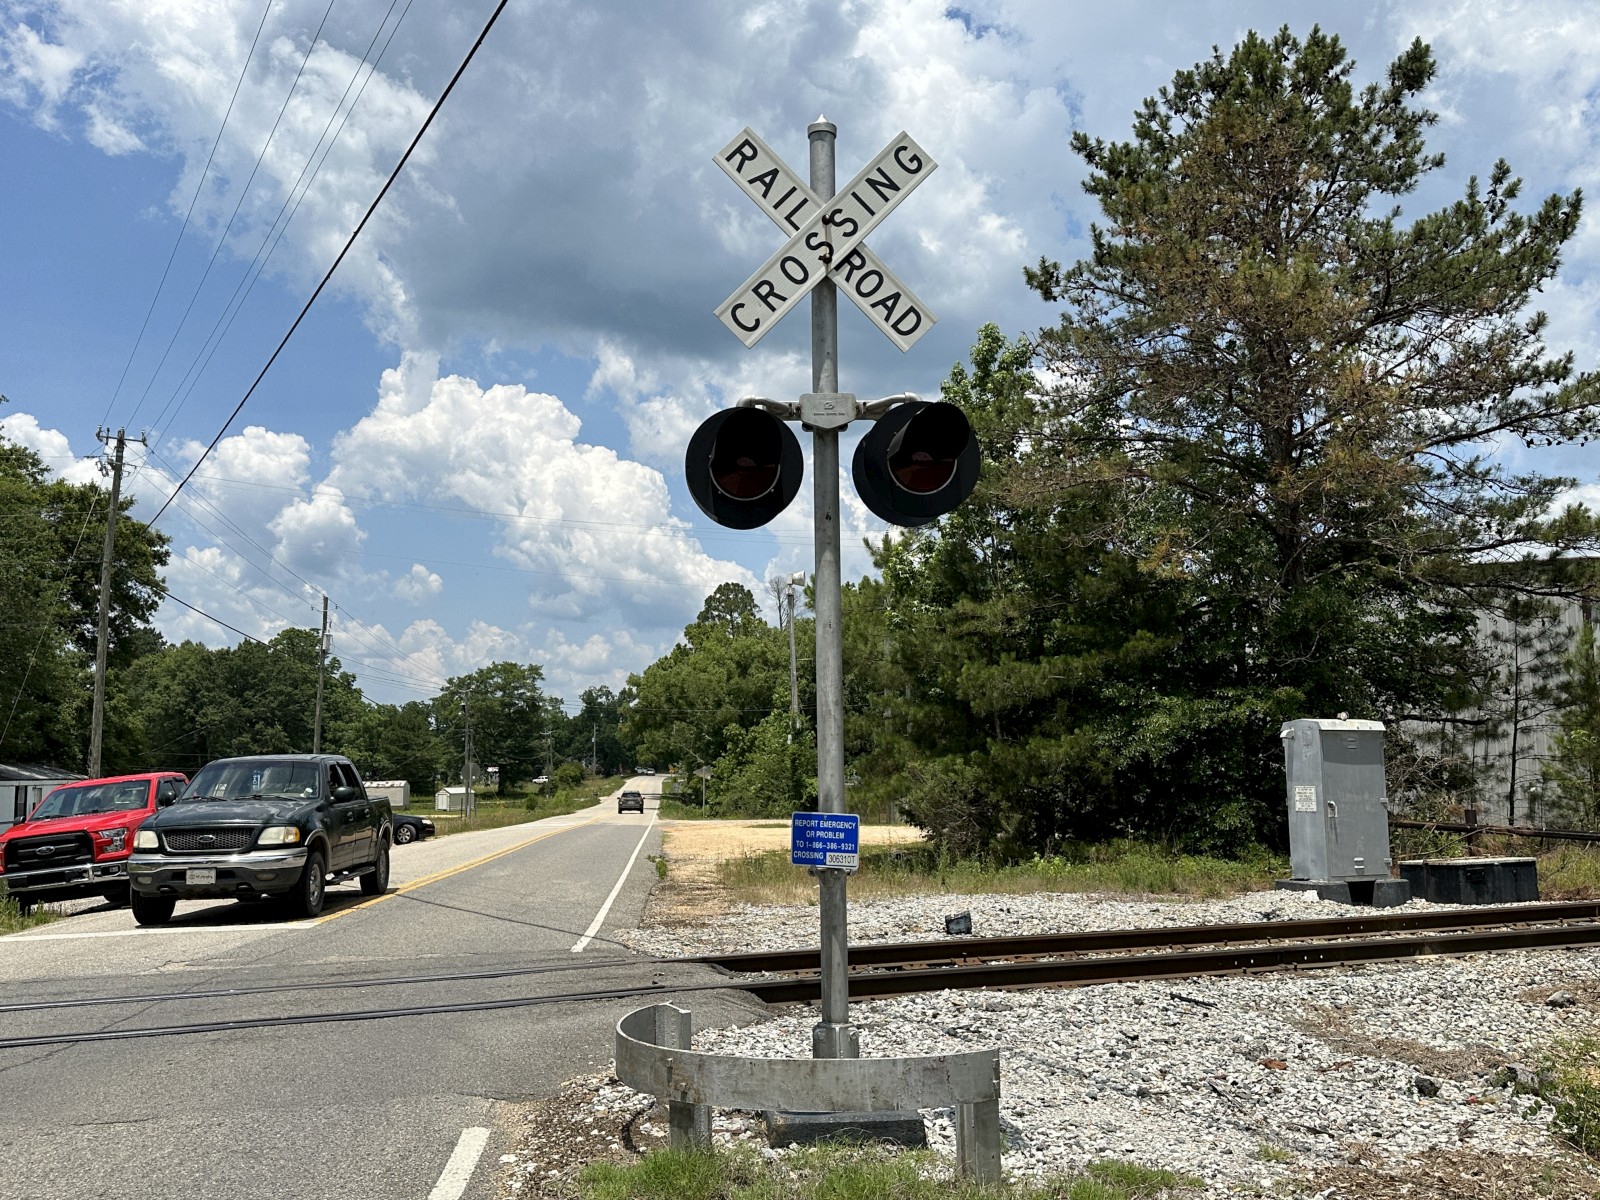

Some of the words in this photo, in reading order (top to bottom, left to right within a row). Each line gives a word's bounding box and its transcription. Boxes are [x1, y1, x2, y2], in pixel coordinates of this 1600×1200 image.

[725, 138, 809, 232] RAIL
[730, 145, 923, 332] CROSSING
[834, 247, 922, 336] ROAD
[795, 820, 818, 828] REPORT
[820, 820, 856, 829] EMERGENCY
[816, 830, 844, 839] PROBLEM
[796, 840, 804, 848] TO
[806, 841, 855, 850] 1-866-386-9321
[794, 851, 824, 859] CROSSING
